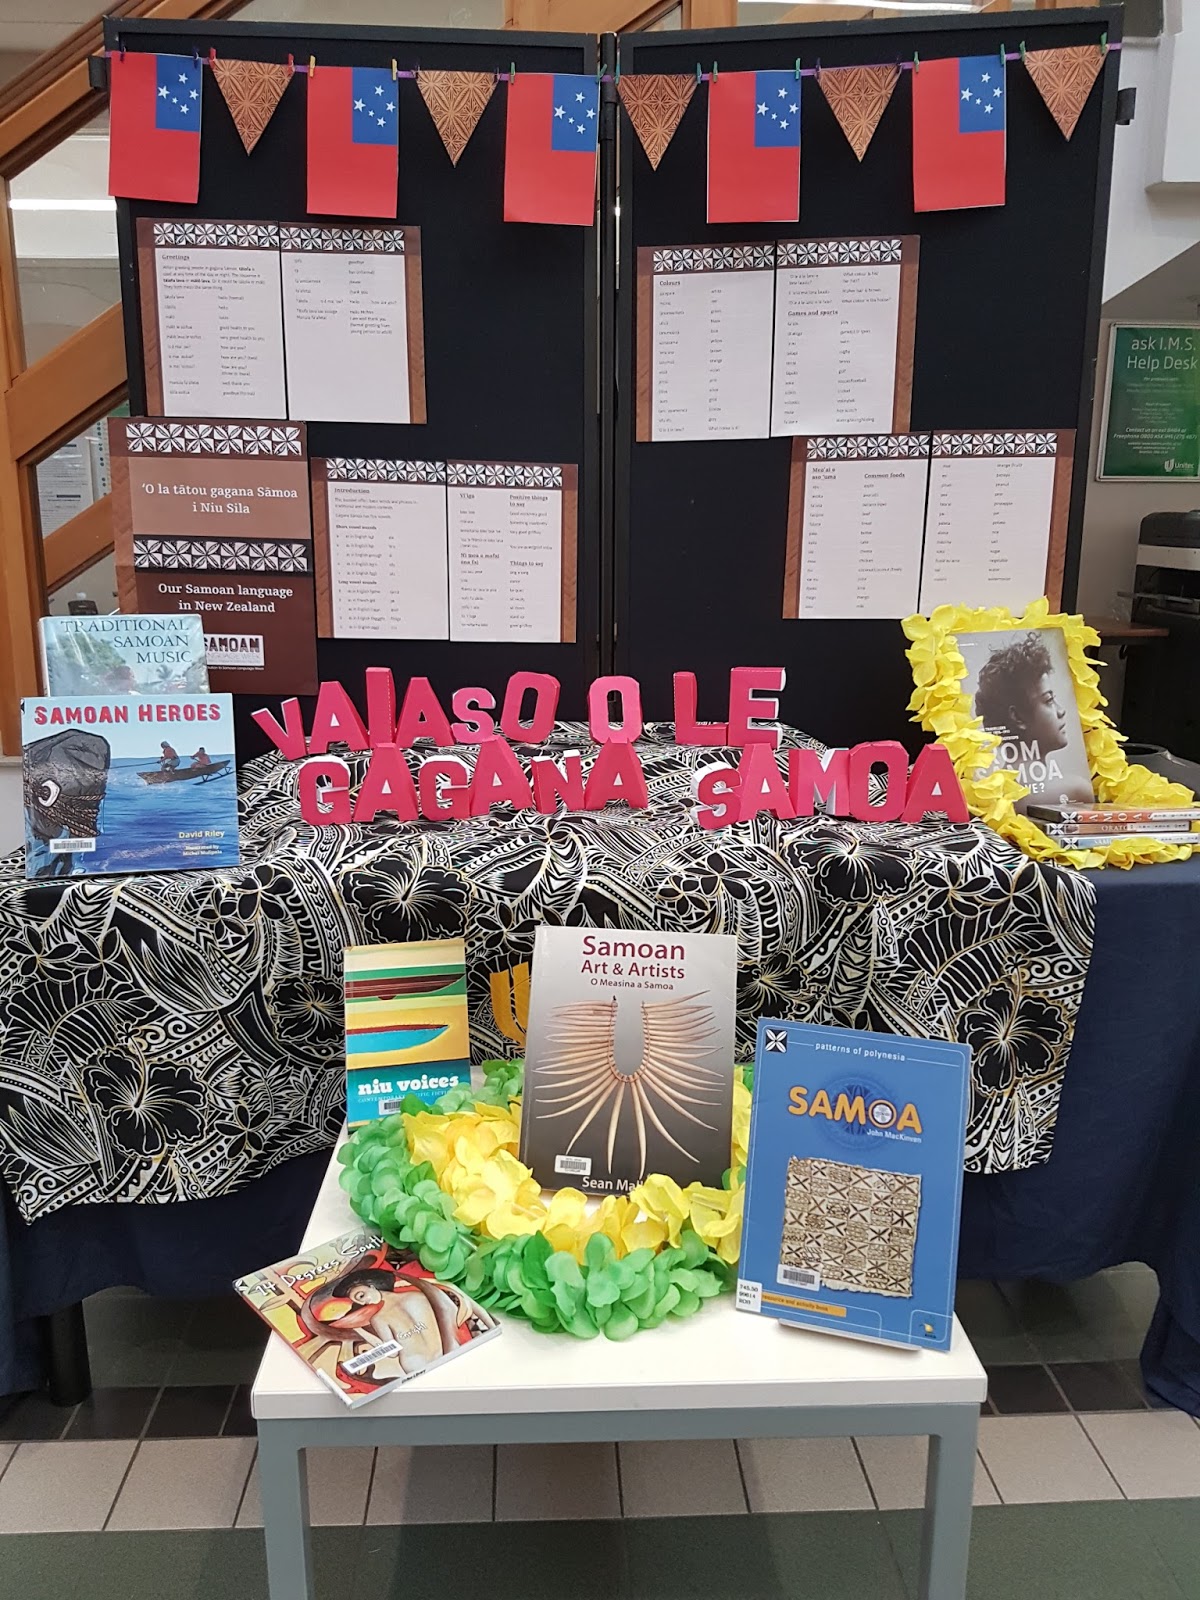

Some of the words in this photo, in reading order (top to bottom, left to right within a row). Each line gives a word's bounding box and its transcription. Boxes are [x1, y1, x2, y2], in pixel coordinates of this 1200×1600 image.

[820, 309, 839, 317] sports
[1131, 336, 1157, 351] ask
[1159, 337, 1197, 351] I.M.S.
[1126, 355, 1160, 373] Help
[1163, 356, 1199, 370] Desk
[158, 484, 170, 495] la
[173, 484, 207, 496] tātou
[210, 487, 255, 499] gagana
[257, 486, 298, 499] Sāmoa
[192, 502, 198, 512] i
[200, 502, 224, 513] Niu
[226, 503, 251, 514] Sila
[158, 583, 183, 594] Our
[185, 583, 235, 595] Samoan
[237, 584, 294, 600] language
[178, 600, 192, 611] in
[195, 600, 224, 612] New
[226, 601, 276, 614] Zealand
[60, 619, 189, 633] TRADITIONAL
[113, 635, 189, 648] SAMOAN
[136, 650, 193, 664] MUSIC
[34, 704, 129, 725] SAMOAN
[138, 703, 222, 722] HEROES
[251, 666, 561, 761] VAIASO
[673, 666, 787, 750] LE
[300, 735, 649, 826] GAGANA
[690, 740, 971, 831] SAMOA
[178, 830, 203, 839] David
[204, 830, 225, 839] Riley
[582, 935, 685, 960] Samoan
[581, 959, 609, 975] Art
[612, 962, 624, 976] &
[628, 962, 685, 979] Artists
[590, 978, 598, 986] O
[599, 978, 635, 988] Measina
[644, 980, 674, 991] Samoa
[815, 1041, 851, 1054] patterns
[853, 1046, 862, 1055] of
[864, 1048, 906, 1062] polynesia
[357, 1078, 393, 1096] niu
[396, 1074, 459, 1092] voices
[787, 1085, 923, 1135] SAMOA
[866, 1128, 884, 1138] John
[582, 1175, 613, 1190] Sean
[255, 1280, 277, 1296] 14
[280, 1258, 341, 1288] Degrees
[340, 1234, 384, 1259] South
